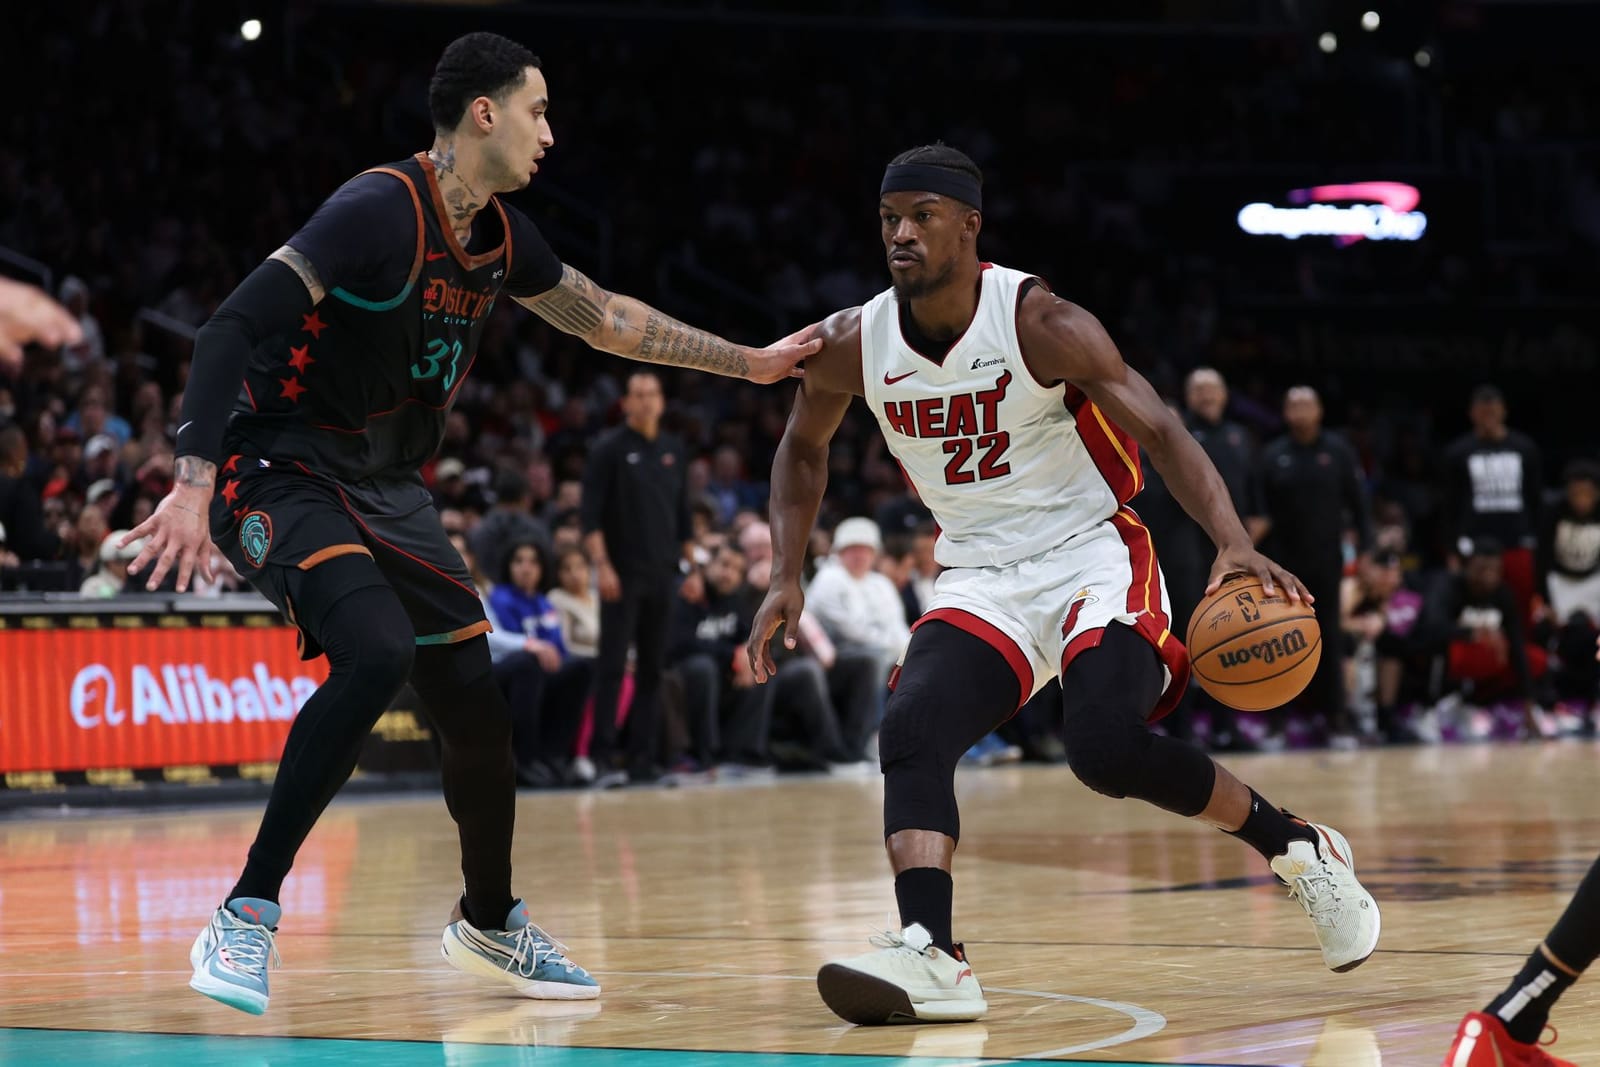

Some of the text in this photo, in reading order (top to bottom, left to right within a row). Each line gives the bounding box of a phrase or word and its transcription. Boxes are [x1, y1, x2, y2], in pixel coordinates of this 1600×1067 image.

[410, 338, 463, 391] 33
[978, 356, 1006, 368] Carnival
[884, 369, 1012, 438] HEAT
[942, 430, 1011, 485] 22
[1217, 627, 1308, 669] Wilson
